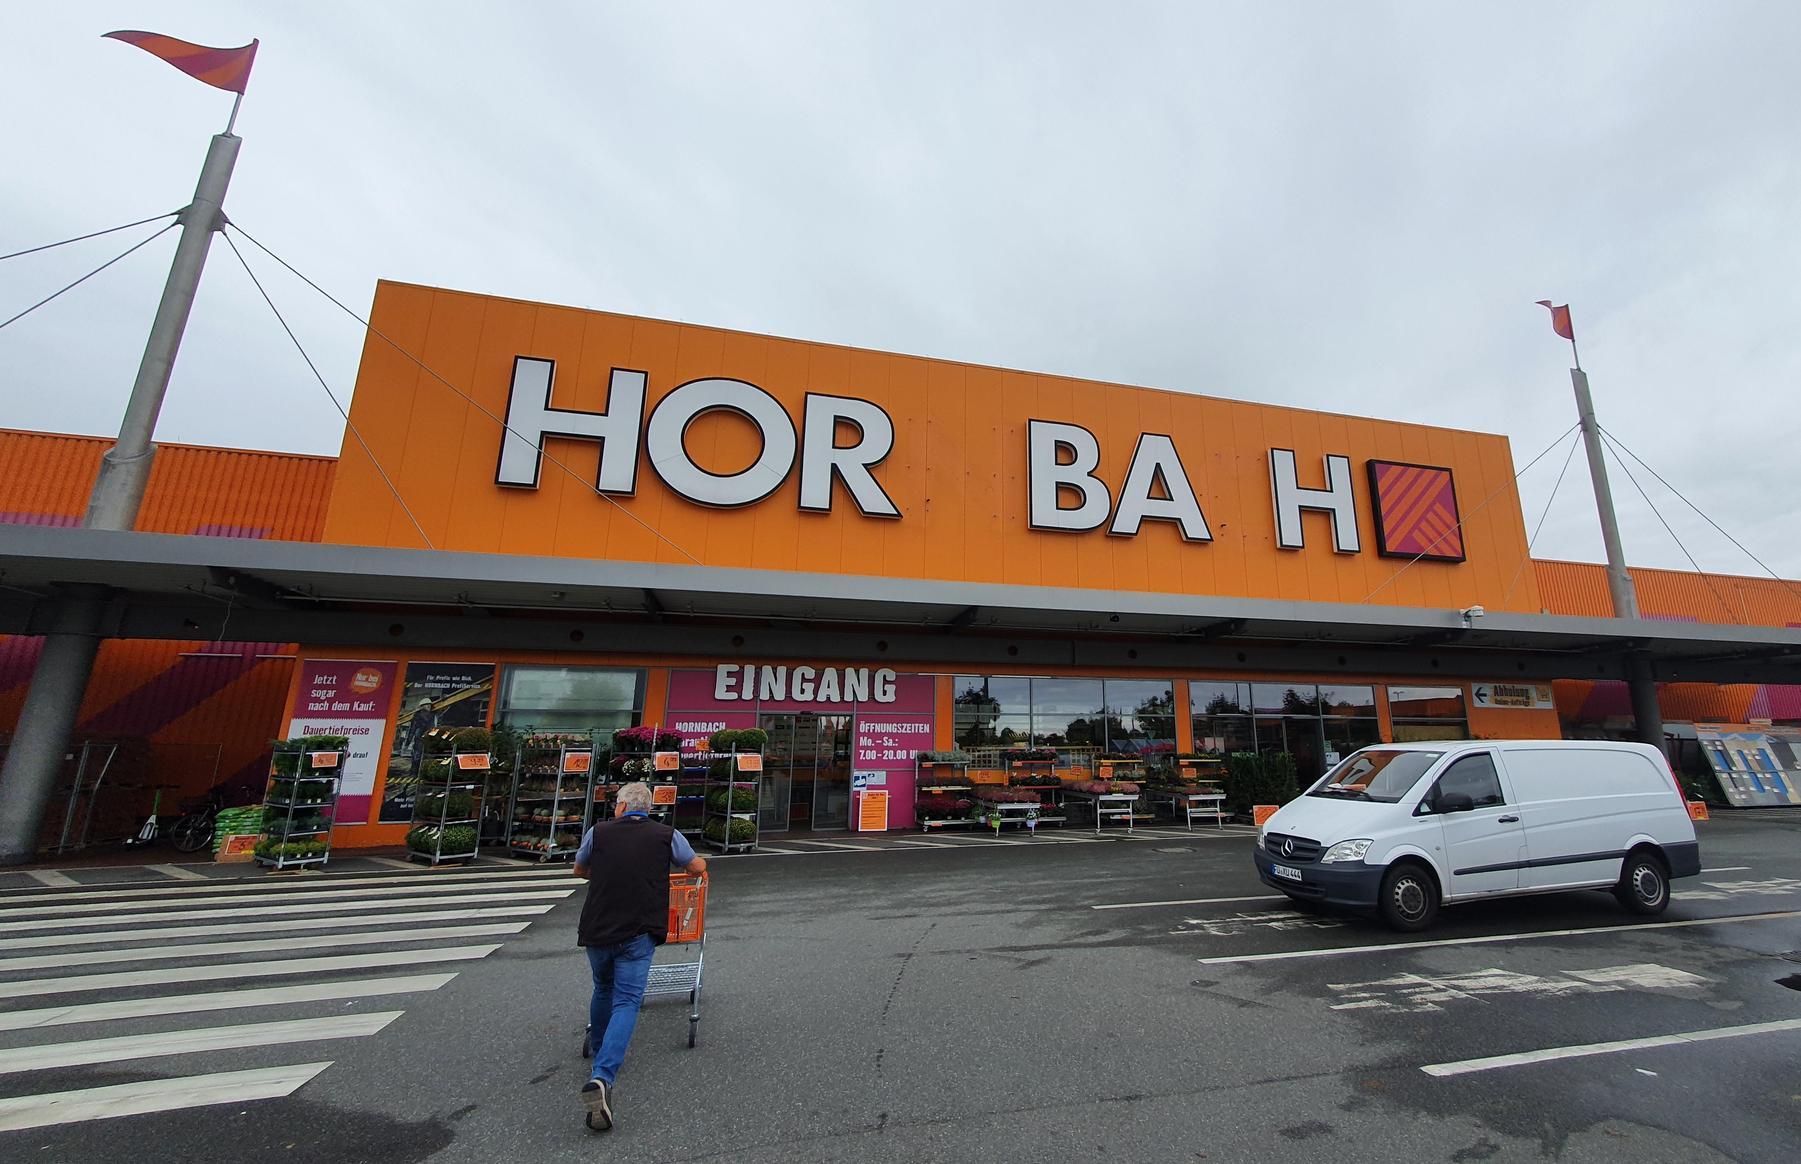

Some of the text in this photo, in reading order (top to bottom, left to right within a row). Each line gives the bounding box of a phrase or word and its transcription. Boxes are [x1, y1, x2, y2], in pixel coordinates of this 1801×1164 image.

[494, 354, 904, 520] HOR
[313, 674, 337, 685] Jetzt
[714, 664, 896, 703] EINGANG
[310, 689, 337, 700] sogar
[308, 701, 376, 711] nach dem Kauf:
[303, 725, 370, 737] Dauertiefpreise
[675, 722, 726, 733] HORNBACH
[859, 720, 931, 734] ÖFFNUNGSZEITEN
